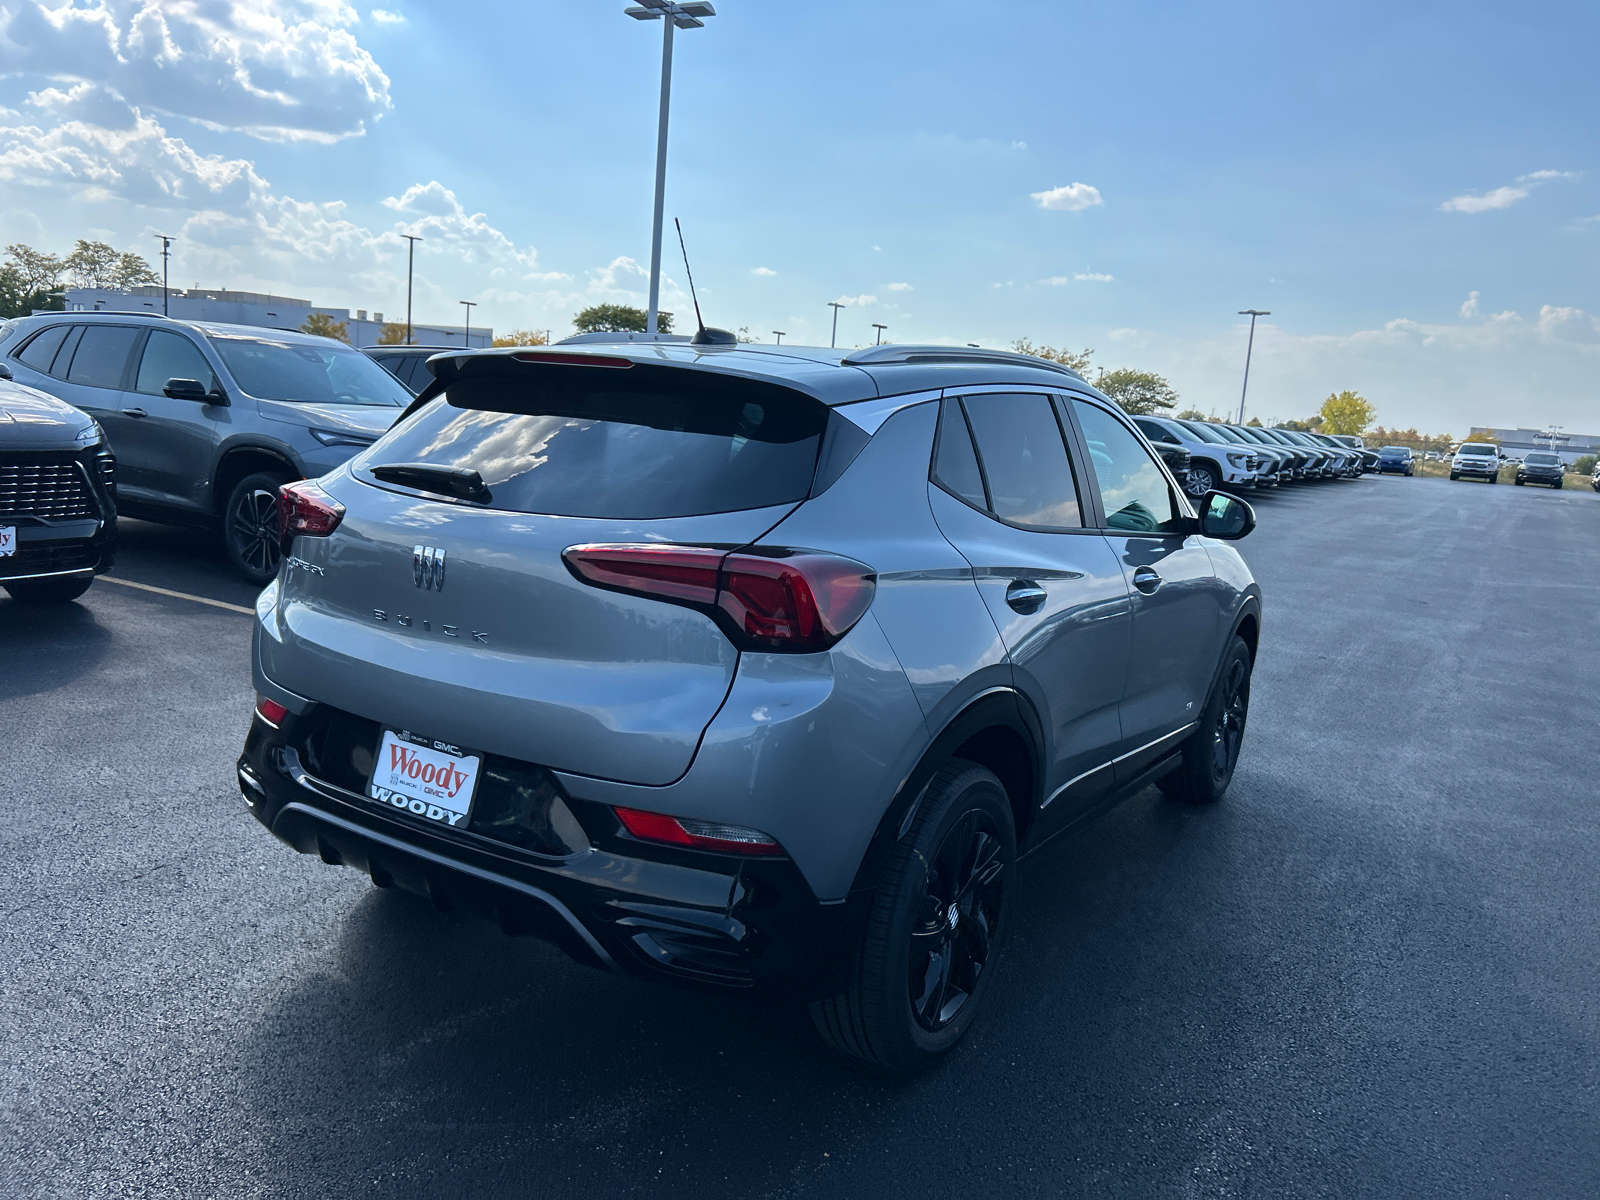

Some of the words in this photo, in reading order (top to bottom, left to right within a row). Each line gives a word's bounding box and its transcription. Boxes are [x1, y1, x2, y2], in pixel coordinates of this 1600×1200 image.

[373, 608, 489, 644] BUICK
[433, 740, 459, 755] GMC
[390, 743, 469, 798] Woody
[399, 779, 418, 789] BUICK
[423, 786, 445, 798] GMC
[371, 785, 463, 826] WOODY
